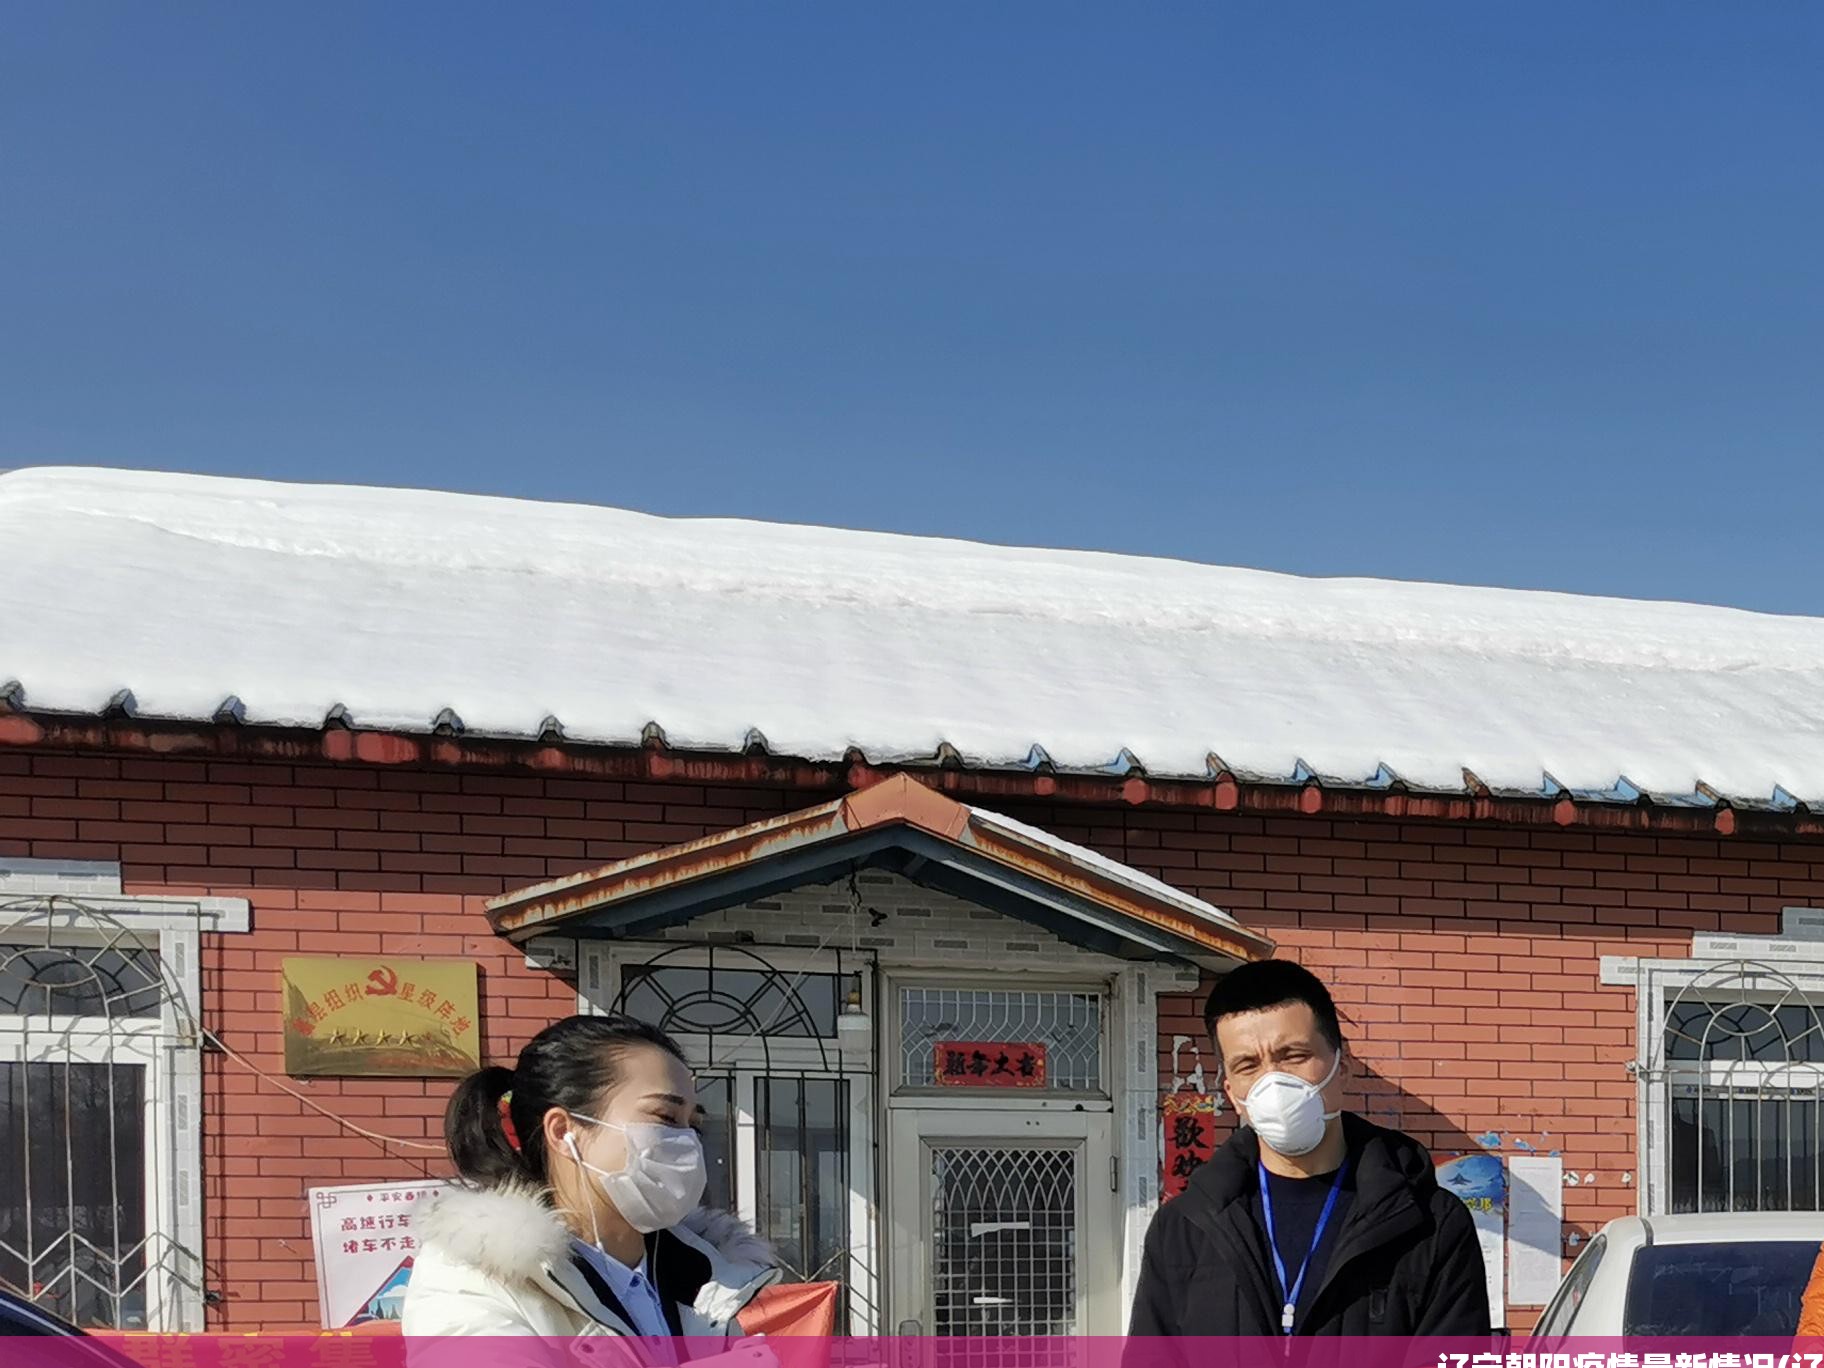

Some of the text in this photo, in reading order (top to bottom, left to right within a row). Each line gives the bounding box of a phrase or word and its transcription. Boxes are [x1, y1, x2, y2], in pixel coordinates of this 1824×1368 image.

[397, 982, 472, 1038] 星级阵地
[341, 1213, 412, 1232] 高速行车
[342, 1235, 422, 1254] 堵车不走
